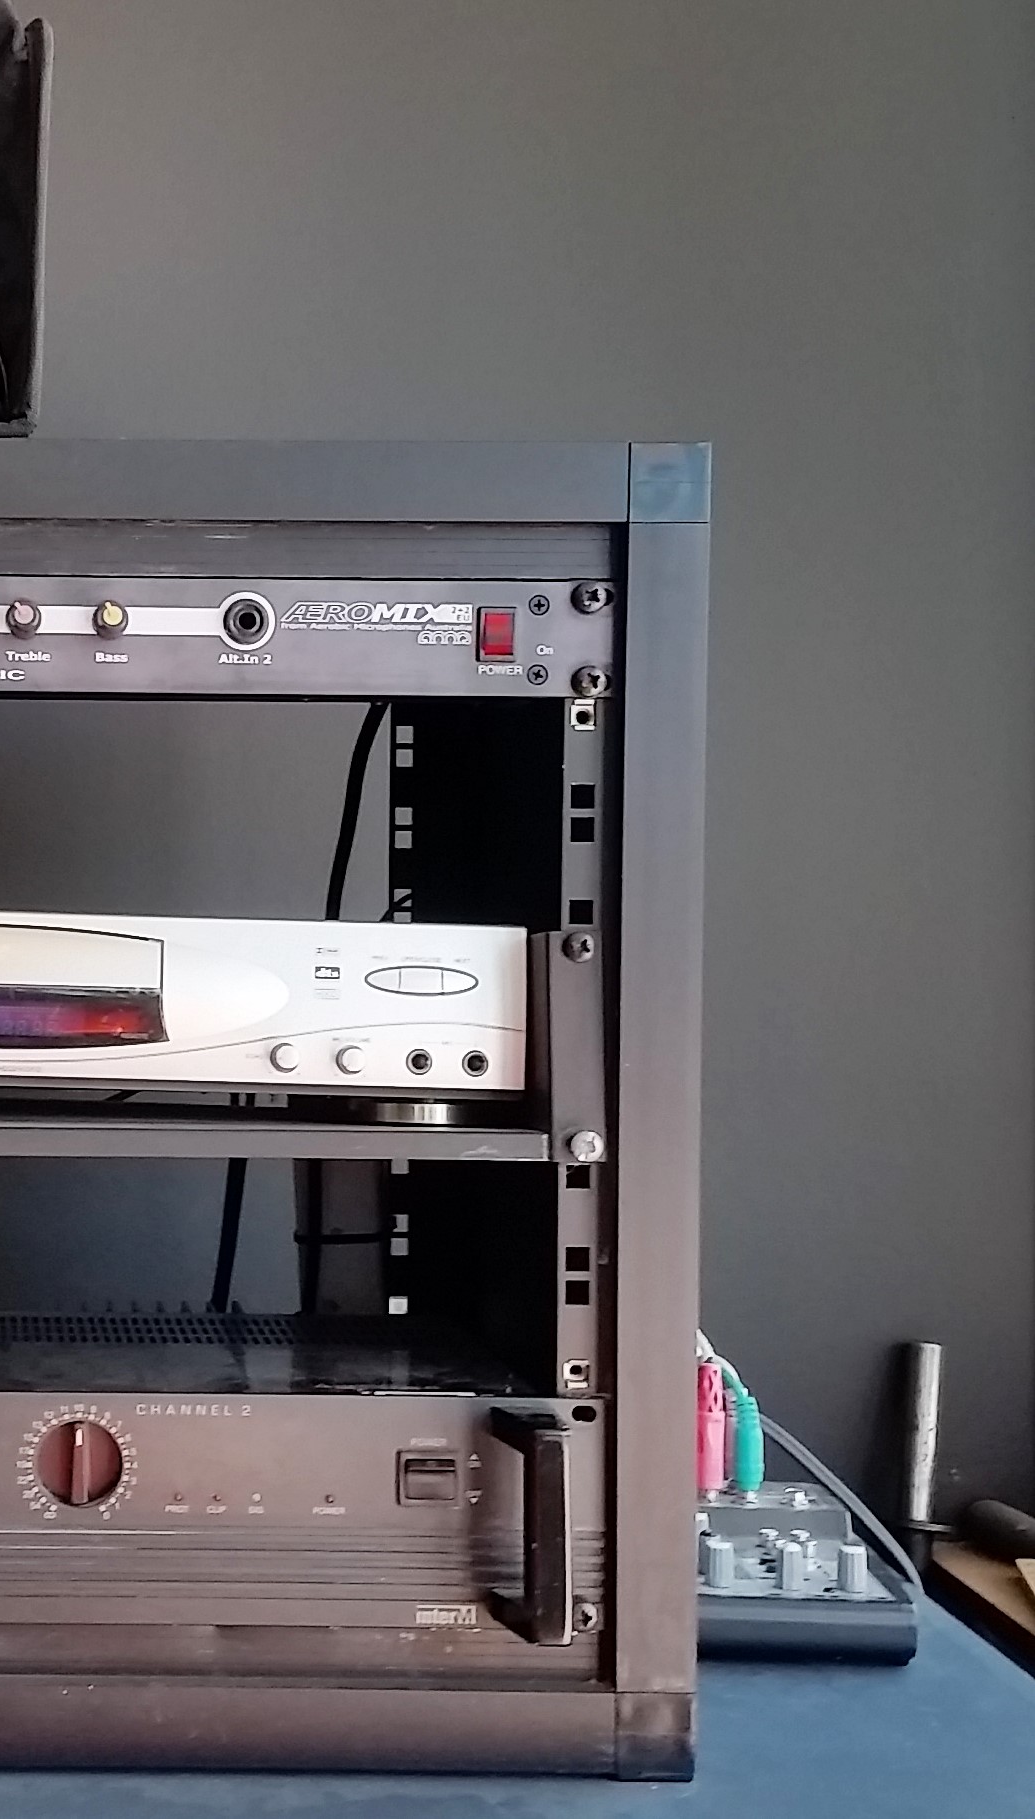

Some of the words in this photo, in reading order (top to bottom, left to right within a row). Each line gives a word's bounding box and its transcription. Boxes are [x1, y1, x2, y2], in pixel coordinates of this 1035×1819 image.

[536, 645, 554, 655] On
[5, 651, 52, 662] Treble
[95, 652, 129, 663] Bass
[262, 654, 272, 665] 2
[477, 665, 523, 676] POWER
[136, 1404, 232, 1416] CHANNEL
[241, 1405, 252, 1417] 2
